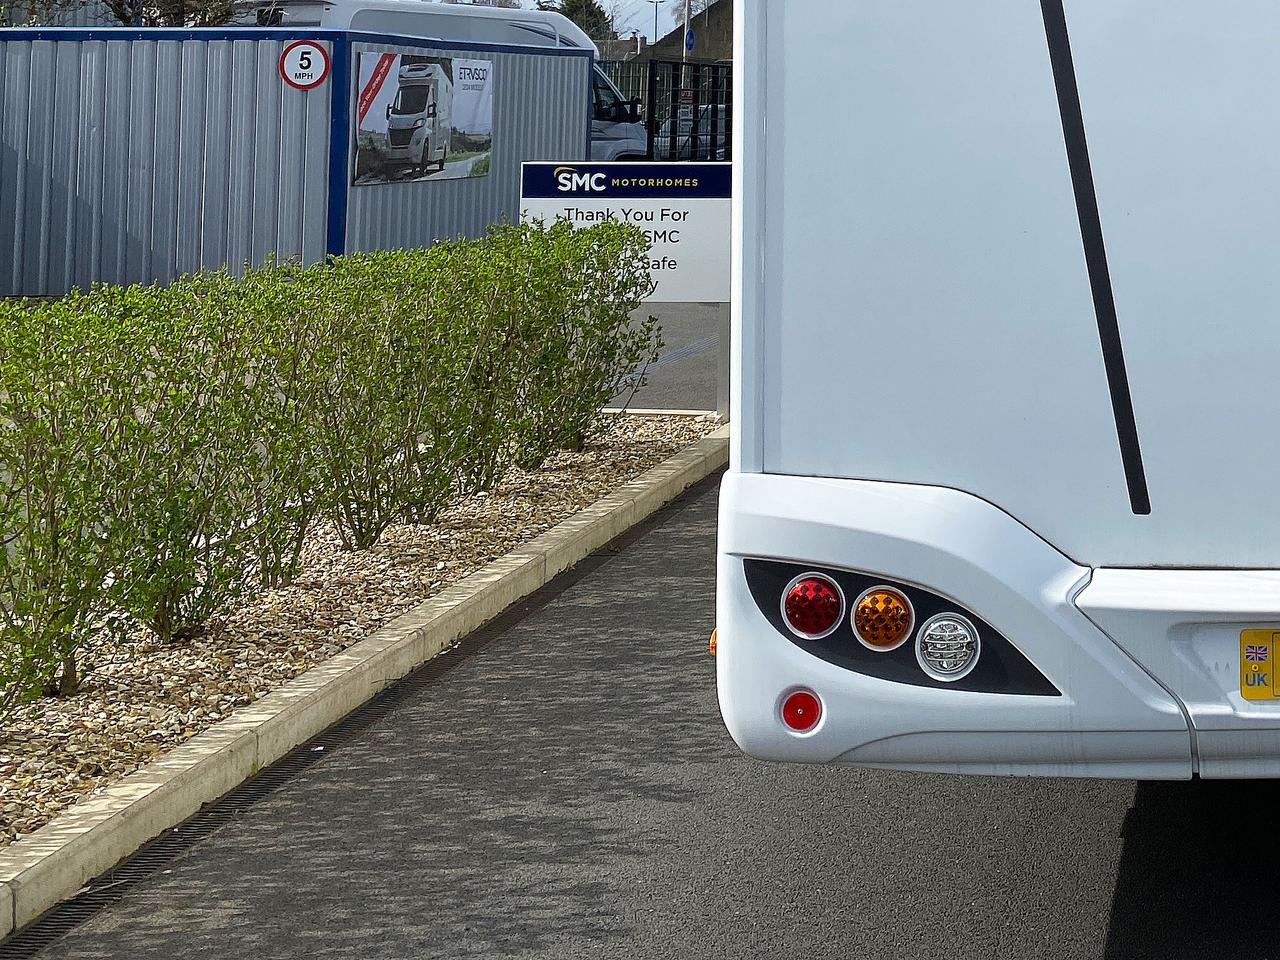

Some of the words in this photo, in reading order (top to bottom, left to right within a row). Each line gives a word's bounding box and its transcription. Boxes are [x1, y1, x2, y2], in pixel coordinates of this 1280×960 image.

[299, 51, 312, 70] 5
[294, 72, 313, 80] MPH
[557, 173, 607, 191] SMC
[611, 178, 699, 187] MOTORHOMES
[564, 207, 615, 222] Thank
[621, 208, 654, 222] You
[660, 208, 689, 222] For
[642, 230, 680, 243] SMC
[1245, 673, 1268, 687] UK
